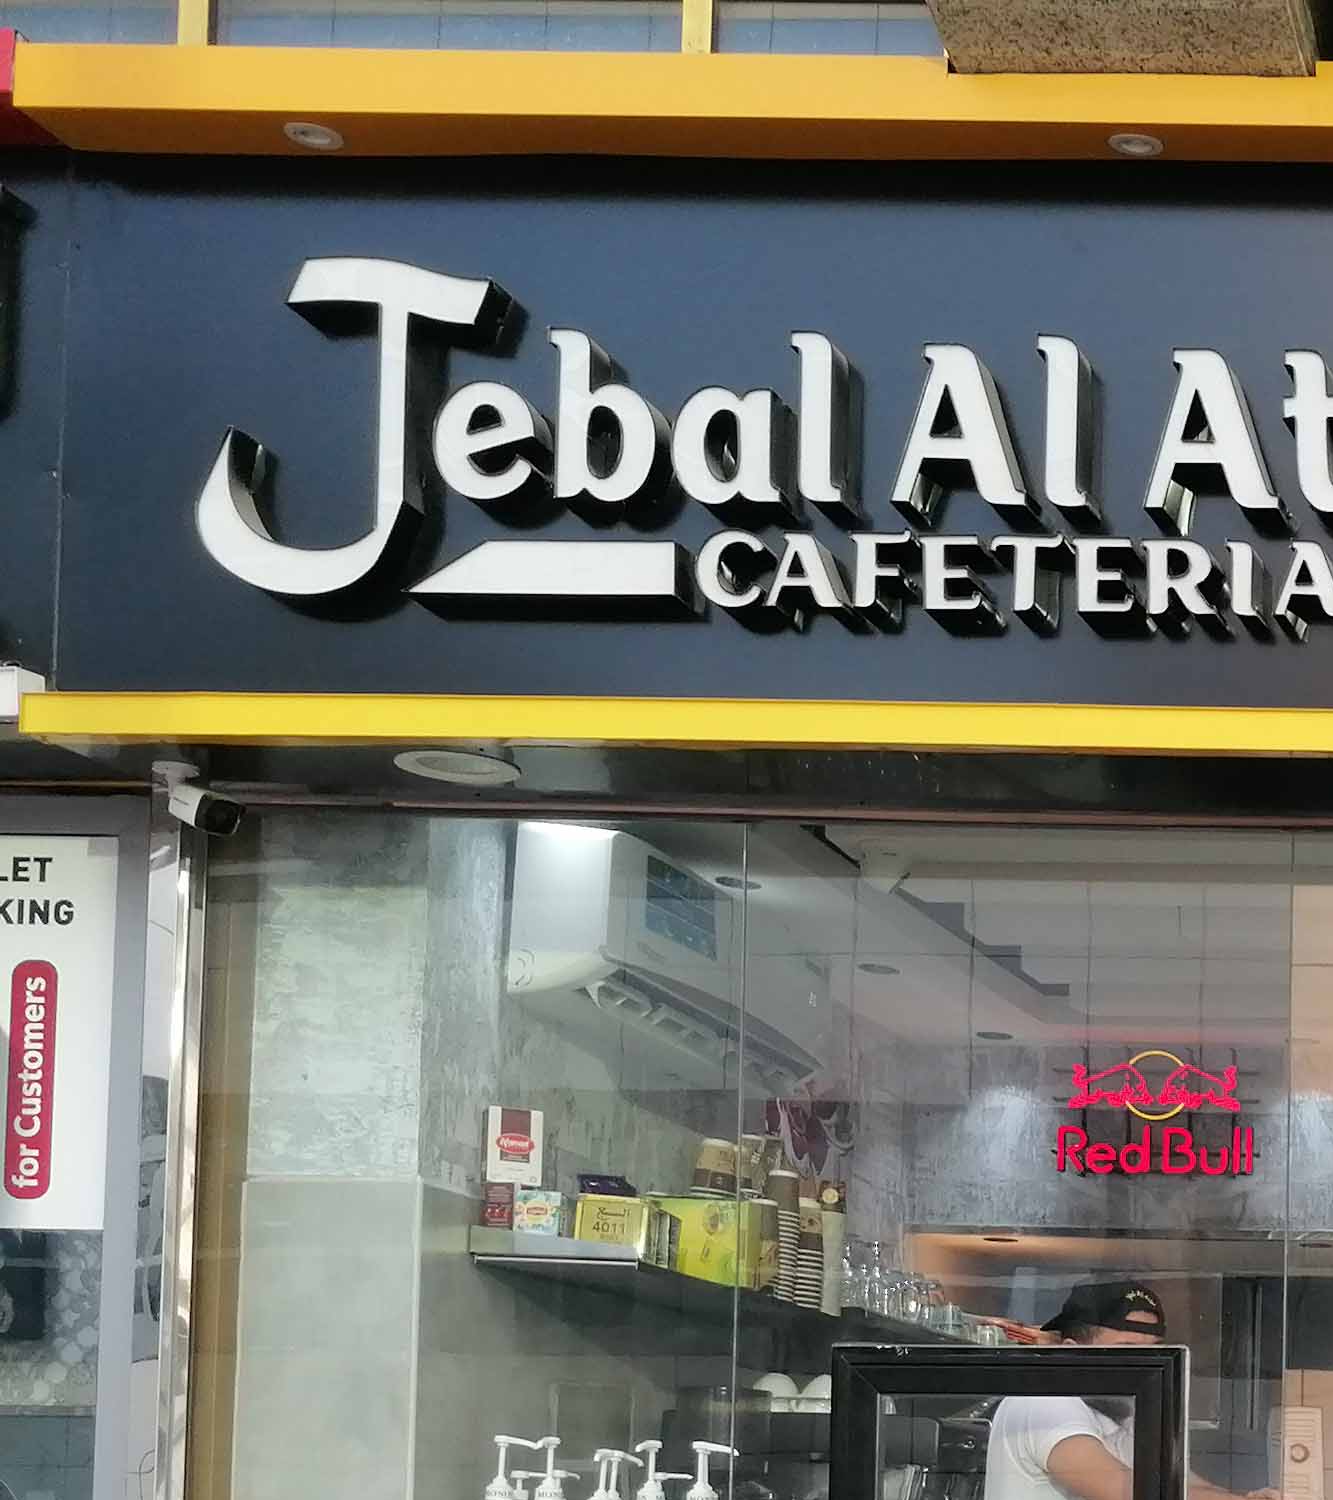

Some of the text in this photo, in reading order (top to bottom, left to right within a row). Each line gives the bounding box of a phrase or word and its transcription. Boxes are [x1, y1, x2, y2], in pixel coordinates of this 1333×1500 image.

[197, 256, 844, 595] Jebal
[890, 333, 1088, 507] Al
[11, 975, 48, 1189] for Customers
[1056, 1124, 1254, 1175] Red Bull
